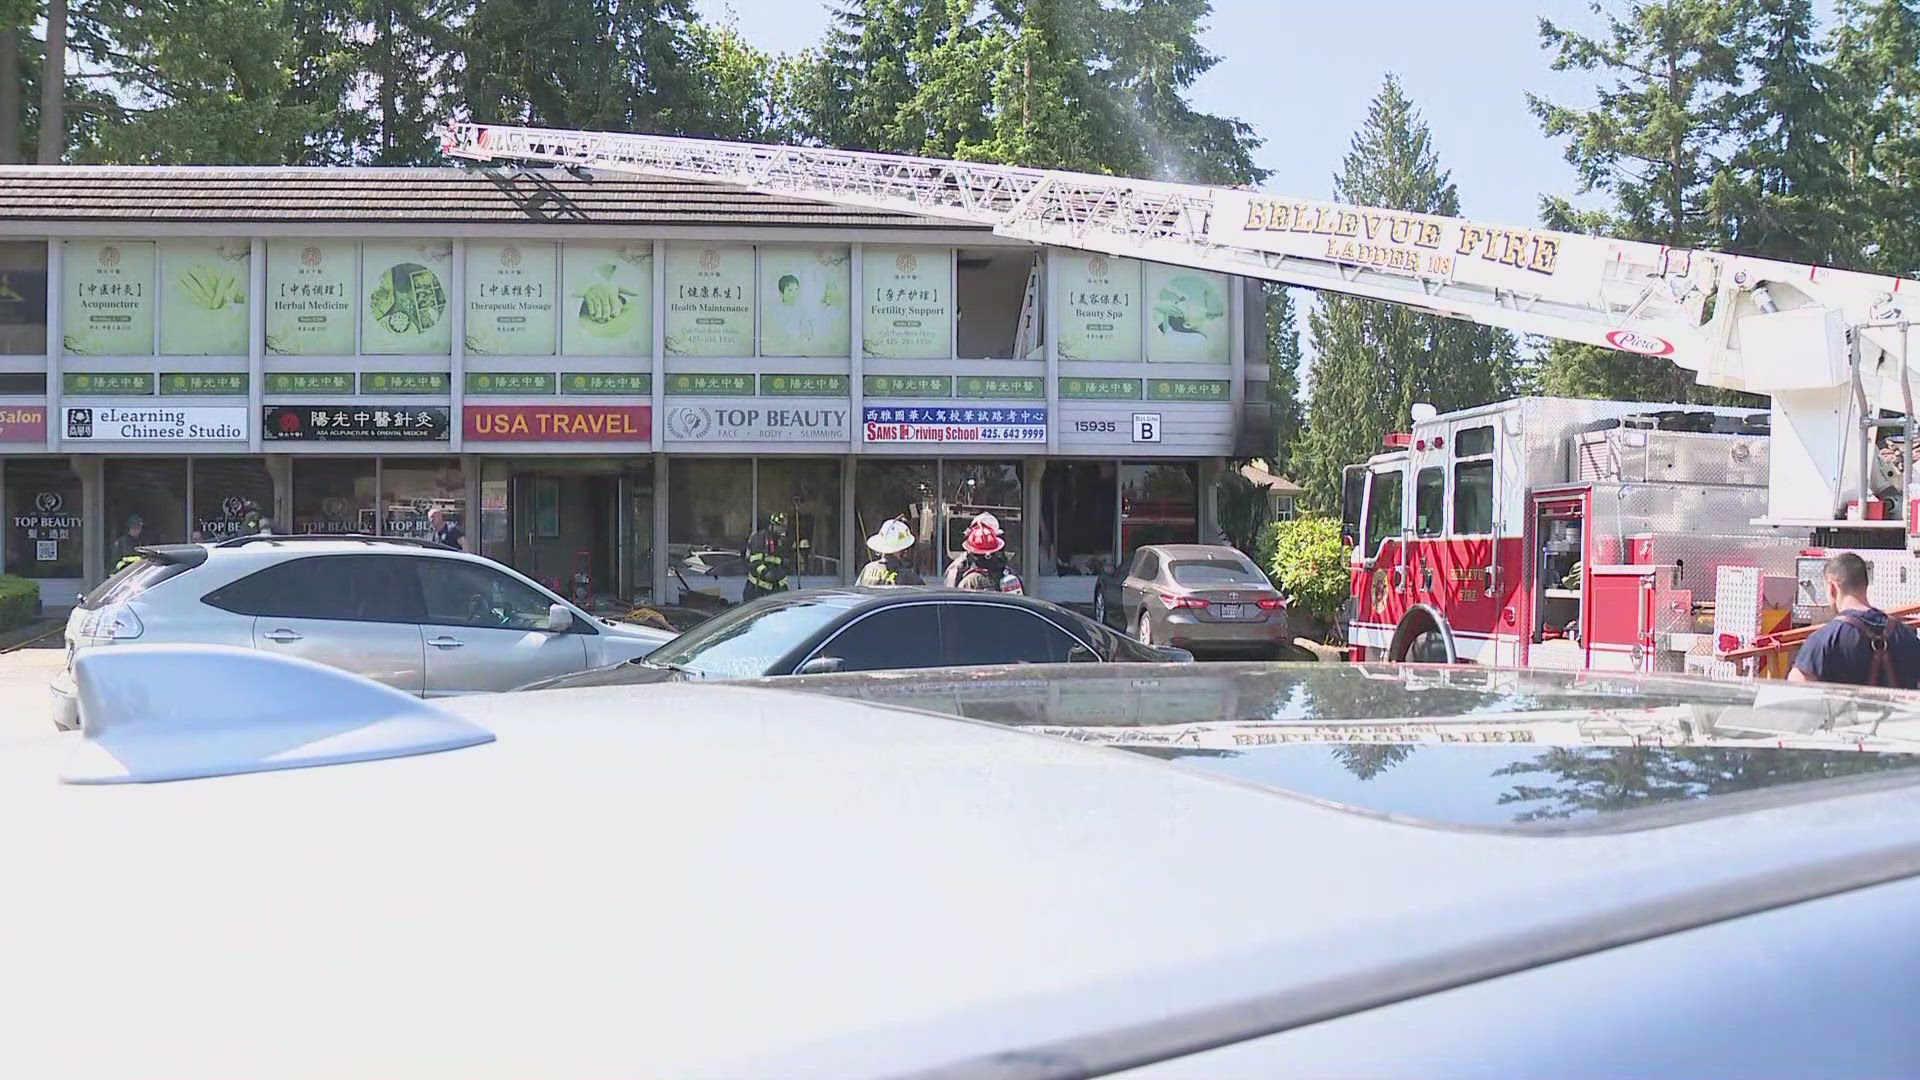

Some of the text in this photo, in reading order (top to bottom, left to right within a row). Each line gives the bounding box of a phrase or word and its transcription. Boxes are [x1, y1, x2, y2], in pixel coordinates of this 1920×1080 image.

[1243, 198, 1562, 275] BELLEVUE FIRE
[1325, 238, 1420, 272] LADDER
[81, 300, 139, 310] Acupuncture
[274, 301, 350, 310] Herbal Medicine
[470, 302, 552, 311] Therapeutic Massage
[671, 303, 749, 312] Health Maintenance
[871, 305, 944, 316] Fertility Support
[1076, 309, 1123, 319] Beauty Spa
[1619, 333, 1658, 350] Pierce
[0, 409, 41, 424] Salon
[100, 409, 186, 426] eLearning
[310, 410, 434, 427] 陽光中醫針灸
[714, 409, 847, 427] TOP BEAUTY
[475, 414, 638, 434] USA TRAVEL
[866, 420, 897, 441] SAMS
[945, 425, 979, 440] School
[1003, 428, 1020, 439] 643
[1021, 428, 1044, 439] 9999
[1075, 421, 1116, 432] 15935
[121, 424, 242, 438] Chinese Studio
[718, 430, 843, 438] FACE BODY SLIMMING
[1141, 422, 1154, 440] B
[14, 517, 83, 527] TOP BEAUTY
[200, 521, 224, 532] TOP
[302, 522, 369, 532] TOP BEAUTY
[389, 521, 412, 531] TOP
[1450, 568, 1484, 581] BELLEVU
[1460, 589, 1477, 602] FIRE
